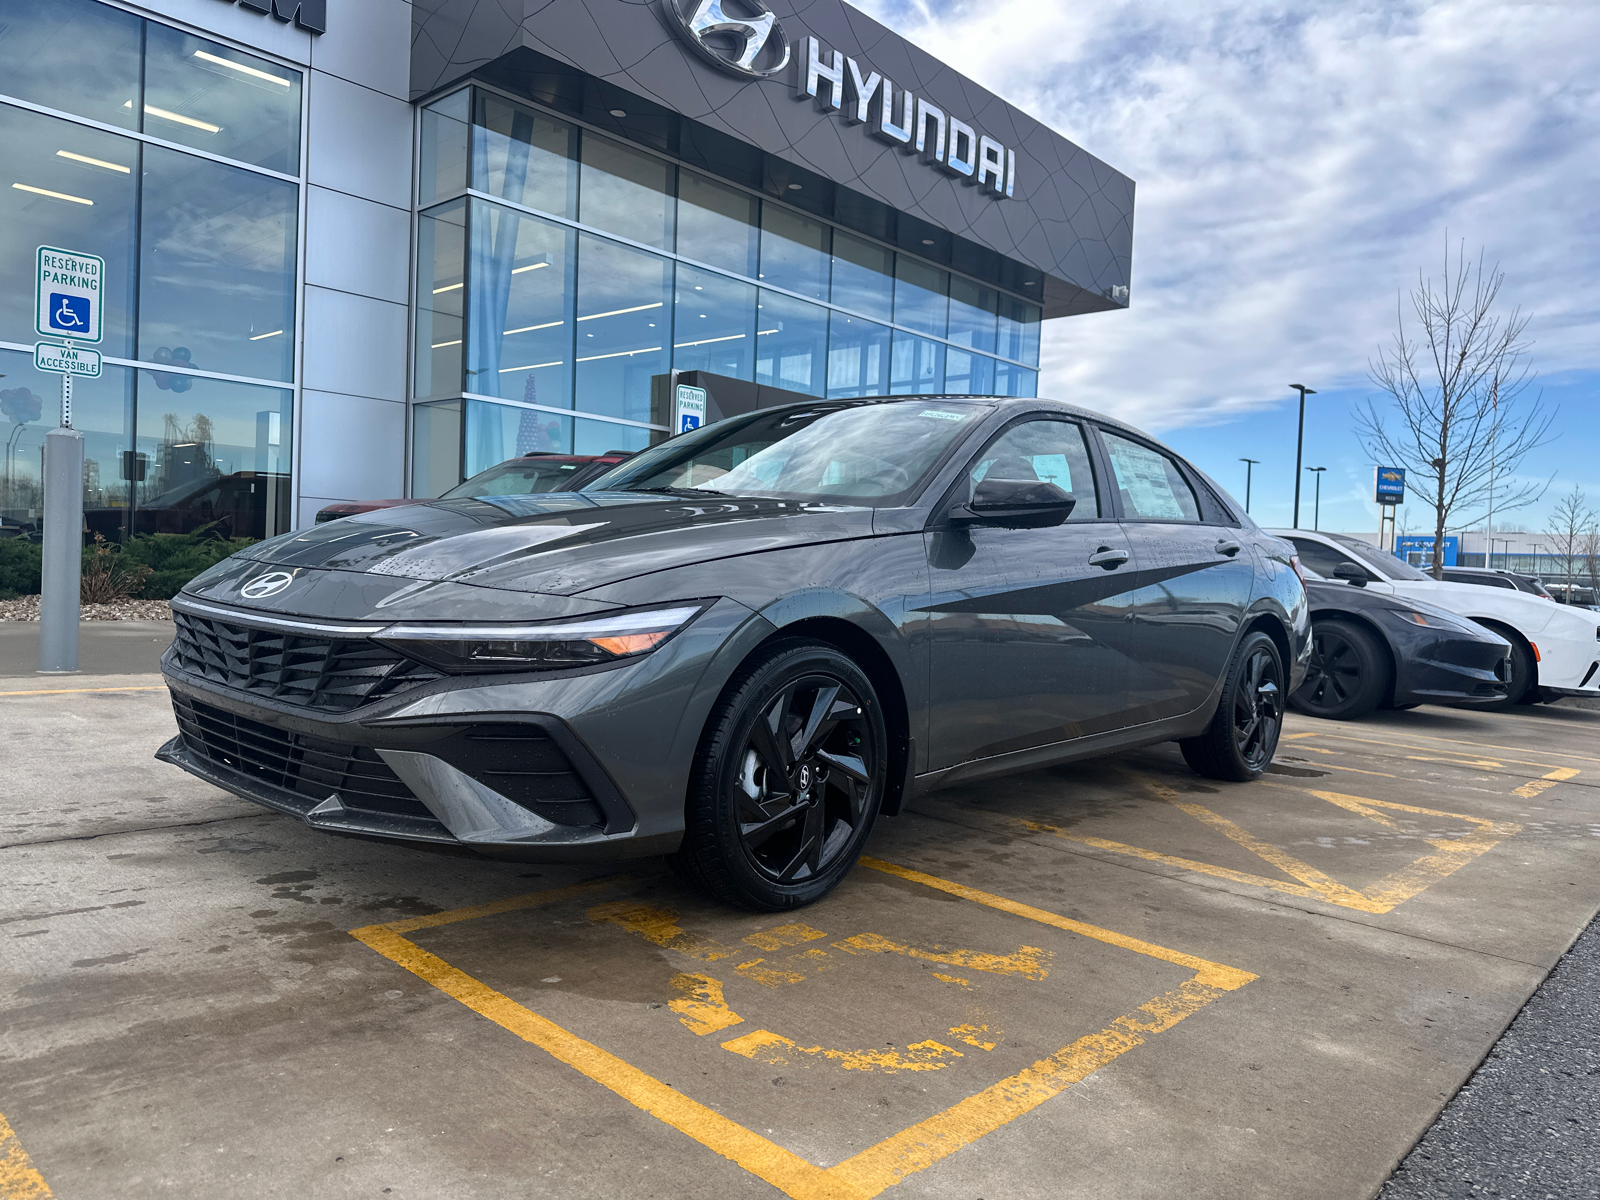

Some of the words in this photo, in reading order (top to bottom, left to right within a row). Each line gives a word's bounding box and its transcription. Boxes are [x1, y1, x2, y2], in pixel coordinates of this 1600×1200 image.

[802, 36, 1015, 198] HYUNDAI
[44, 255, 97, 275] RESERVED
[43, 270, 97, 290] PARKING
[60, 349, 78, 360] VAN
[40, 357, 97, 373] ACCESSIBLE
[680, 390, 703, 402] RESERVED
[680, 400, 703, 411] PARKING
